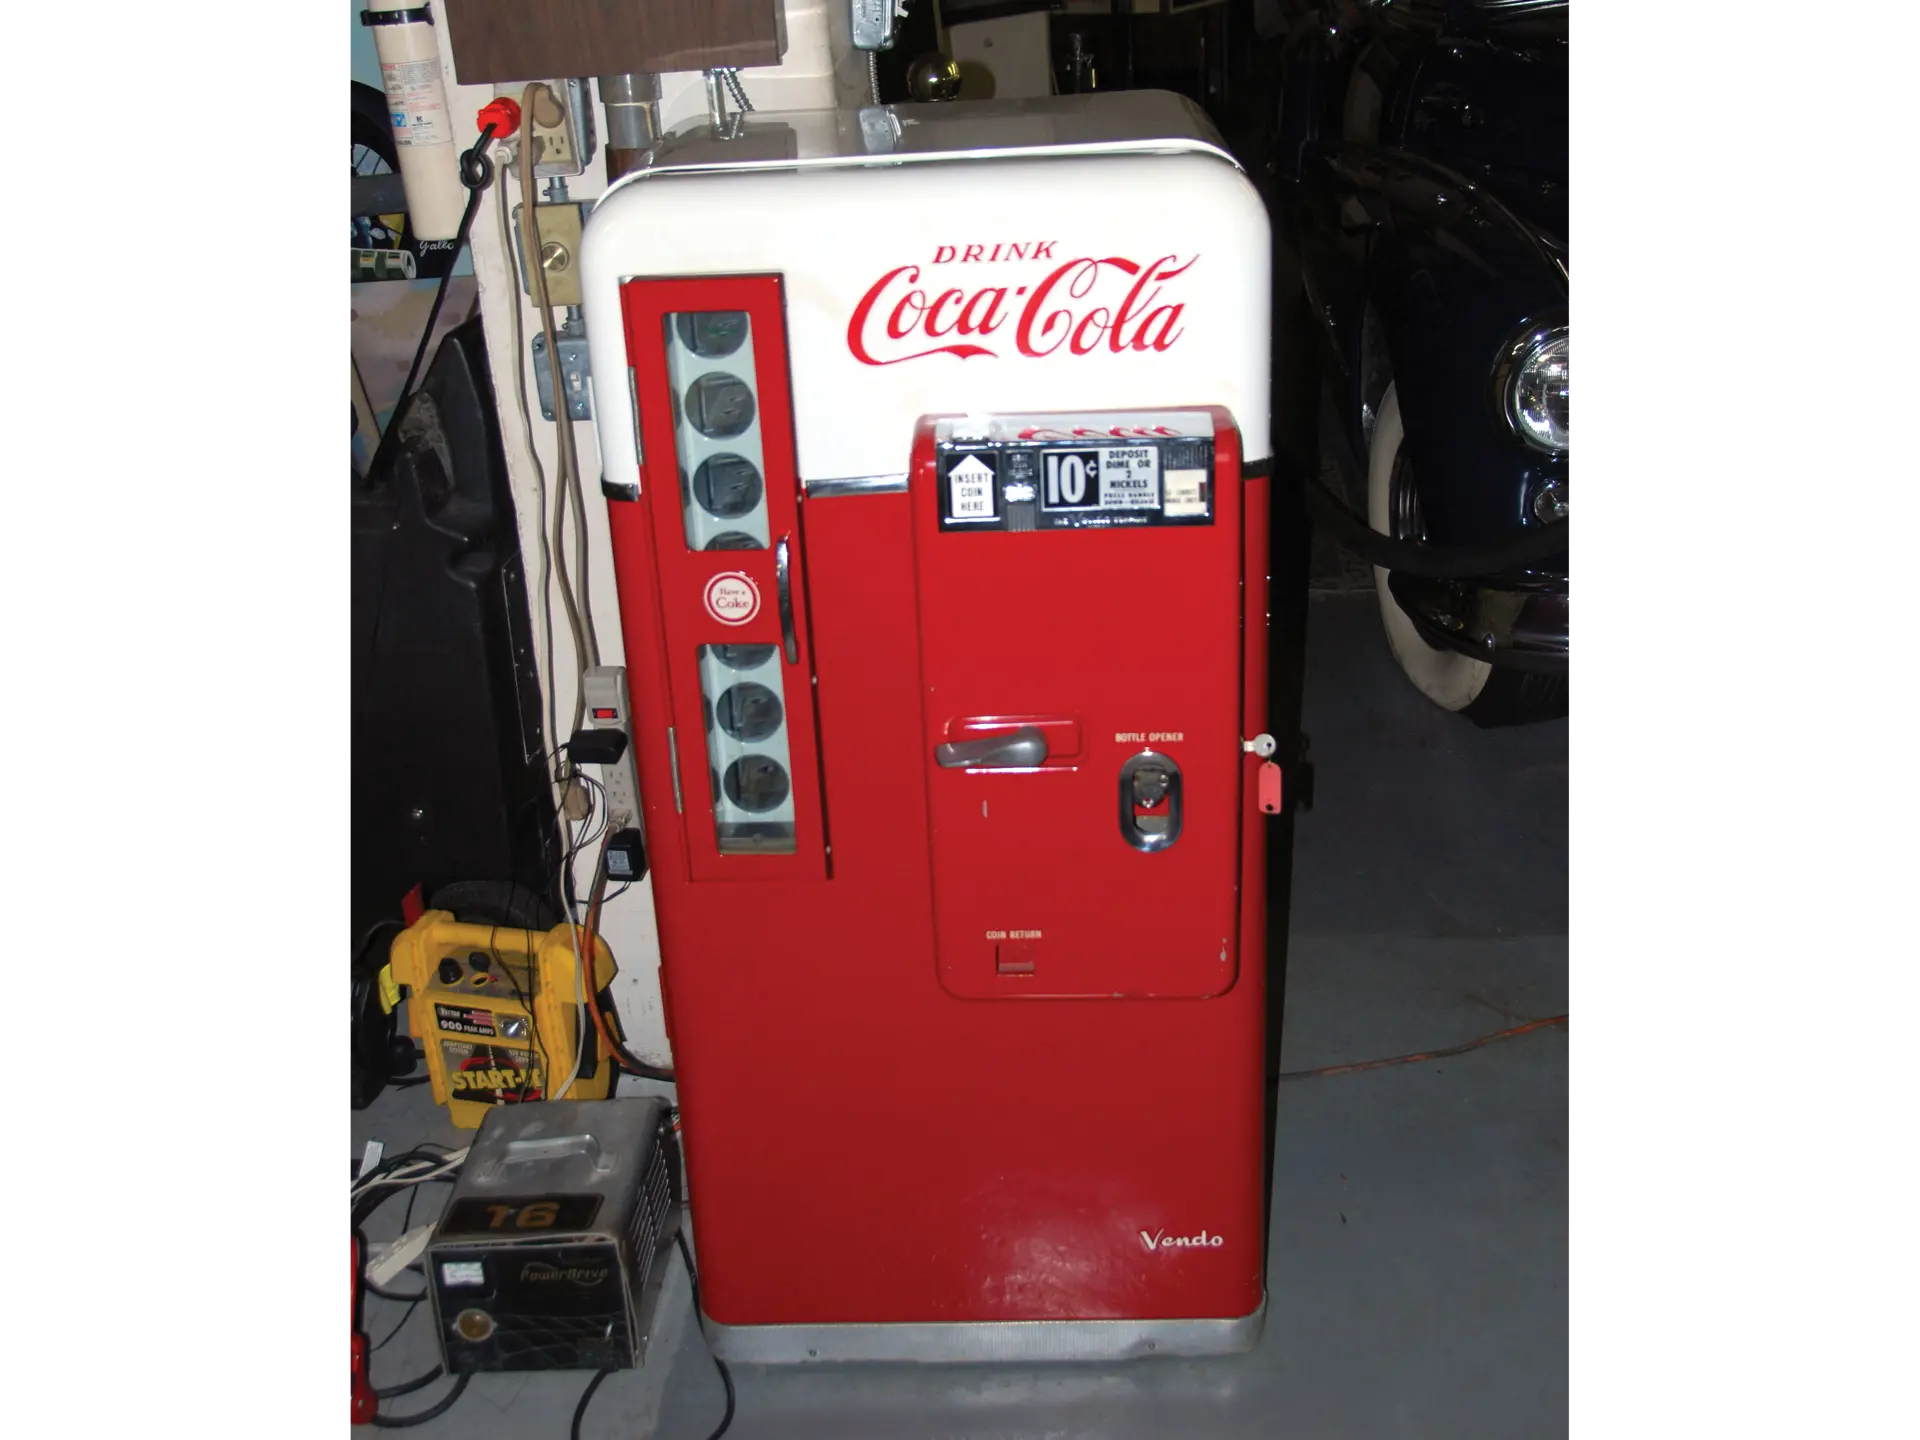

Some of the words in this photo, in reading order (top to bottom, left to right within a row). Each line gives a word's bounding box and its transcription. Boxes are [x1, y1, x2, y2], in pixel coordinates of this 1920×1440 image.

[932, 240, 1058, 263] DRINK
[1108, 449, 1149, 459] DEPOSIT
[1105, 460, 1130, 469] DIME
[1136, 459, 1152, 468] OR
[953, 471, 989, 484] INSERT
[1124, 469, 1132, 479] 2
[1108, 480, 1149, 489] NICKELS
[960, 487, 983, 498] COIN
[960, 500, 985, 511] HERE
[719, 587, 740, 596] Have
[716, 597, 750, 609] Coke
[1114, 732, 1147, 743] BOTTLE
[1148, 731, 1185, 742] OPENER
[985, 930, 1007, 940] COIN
[1009, 929, 1042, 939] RETURN
[440, 1019, 463, 1031] 900
[463, 1025, 478, 1033] PEAK
[479, 1026, 494, 1035] AMPS
[1140, 1228, 1224, 1251] Vendo
